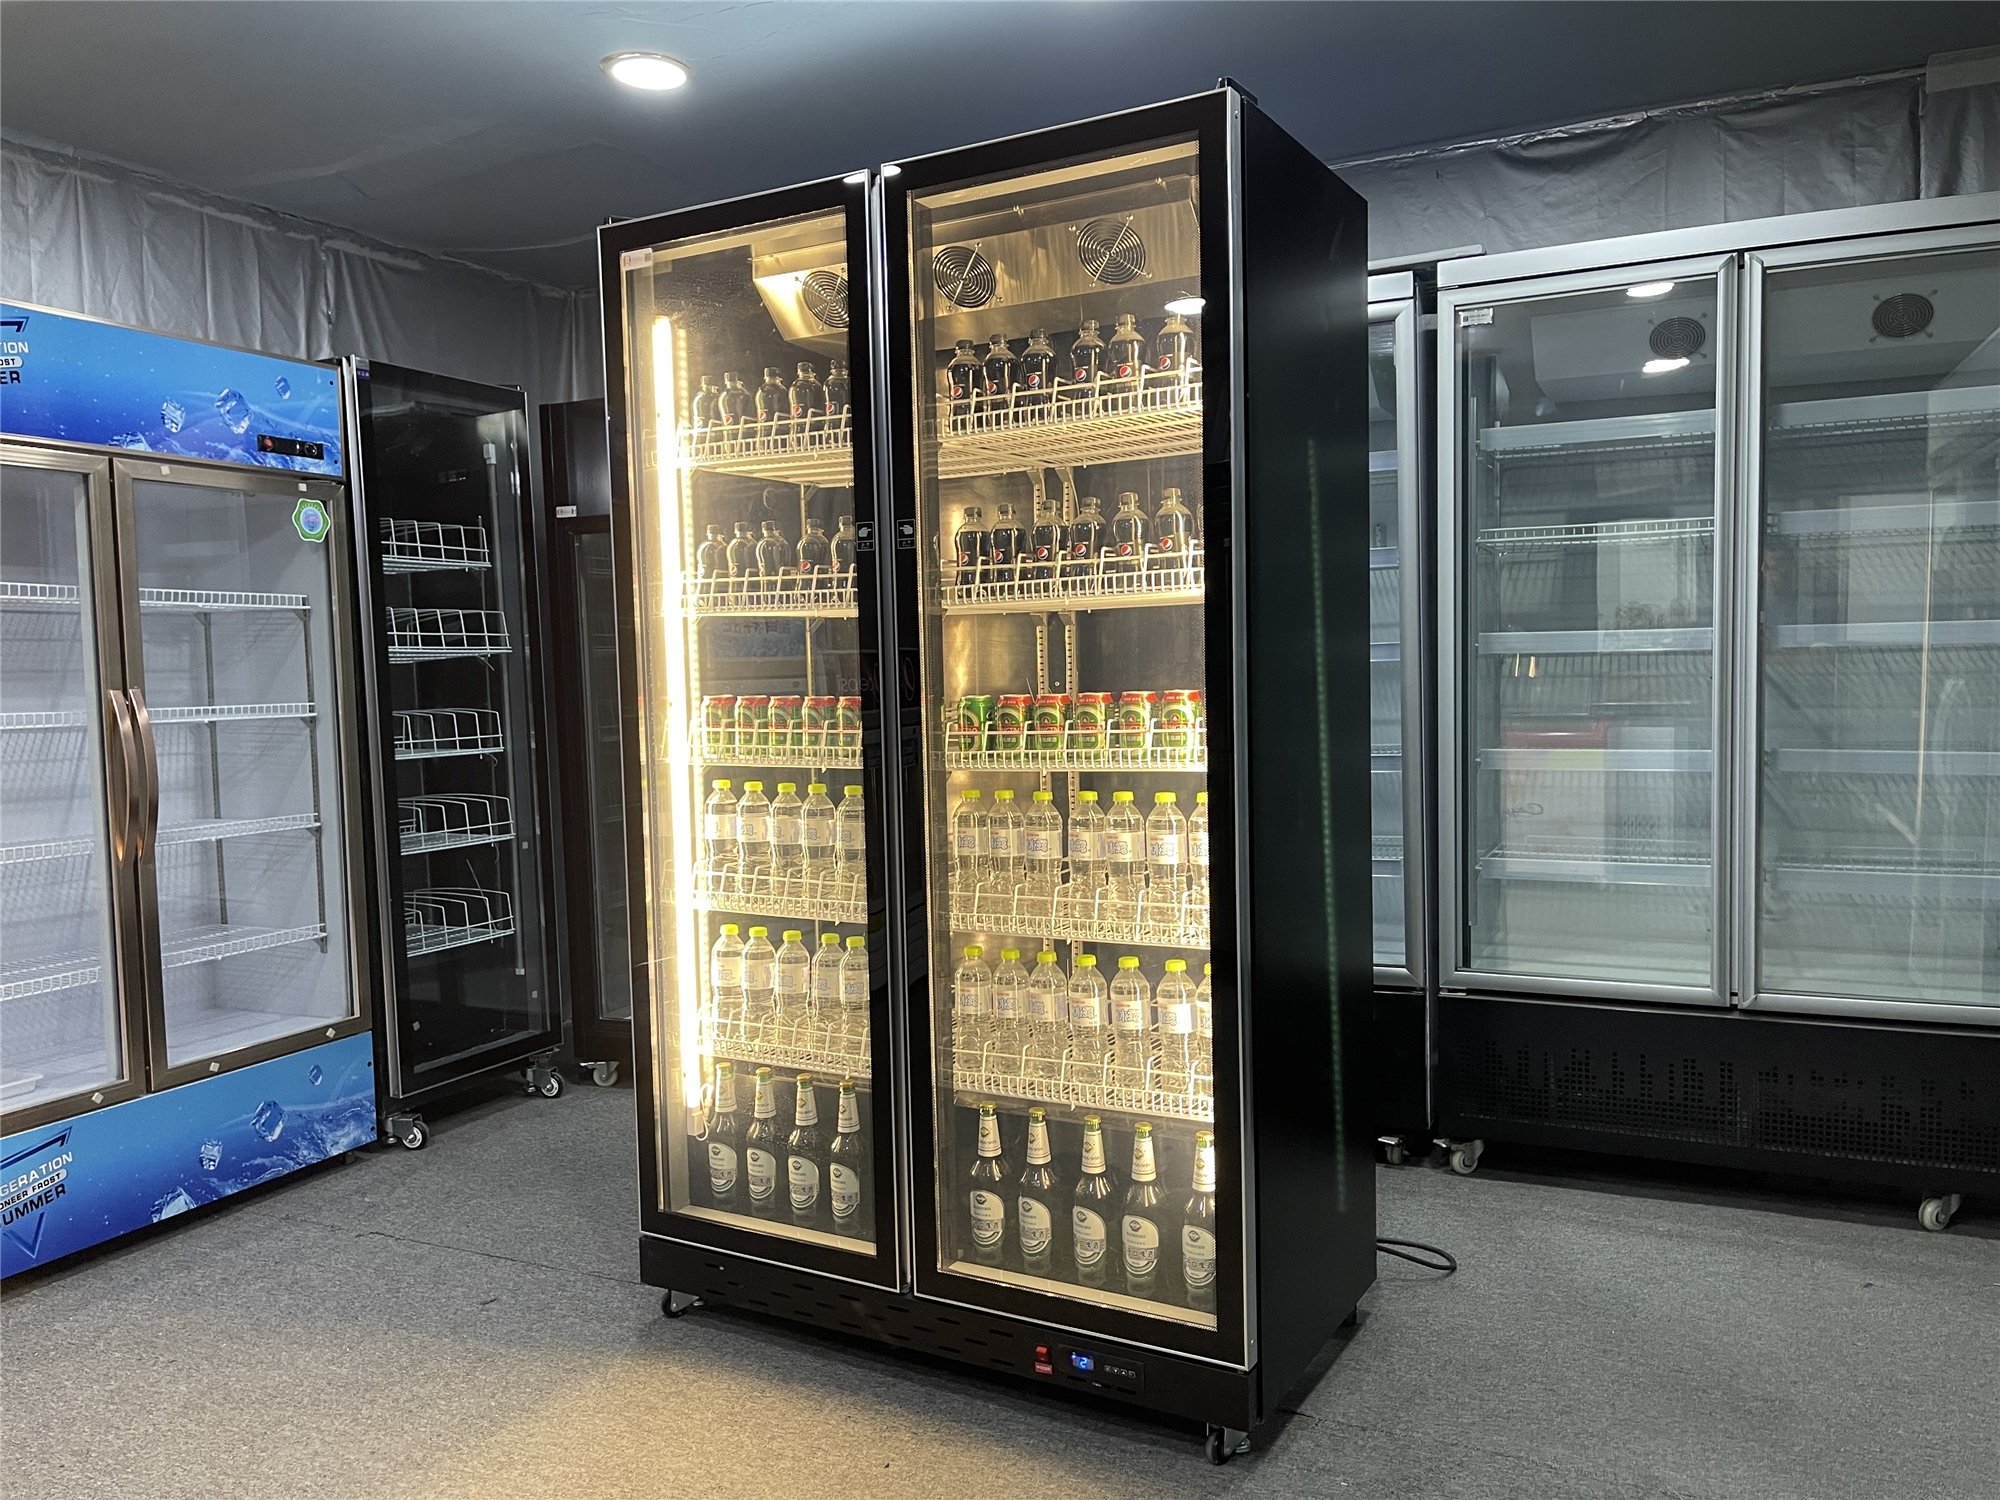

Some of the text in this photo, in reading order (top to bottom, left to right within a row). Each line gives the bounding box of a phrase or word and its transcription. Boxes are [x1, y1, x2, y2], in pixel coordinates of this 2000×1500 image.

[0, 341, 29, 354] ION
[32, 1172, 61, 1193] FROST
[0, 1183, 66, 1227] UMMER
